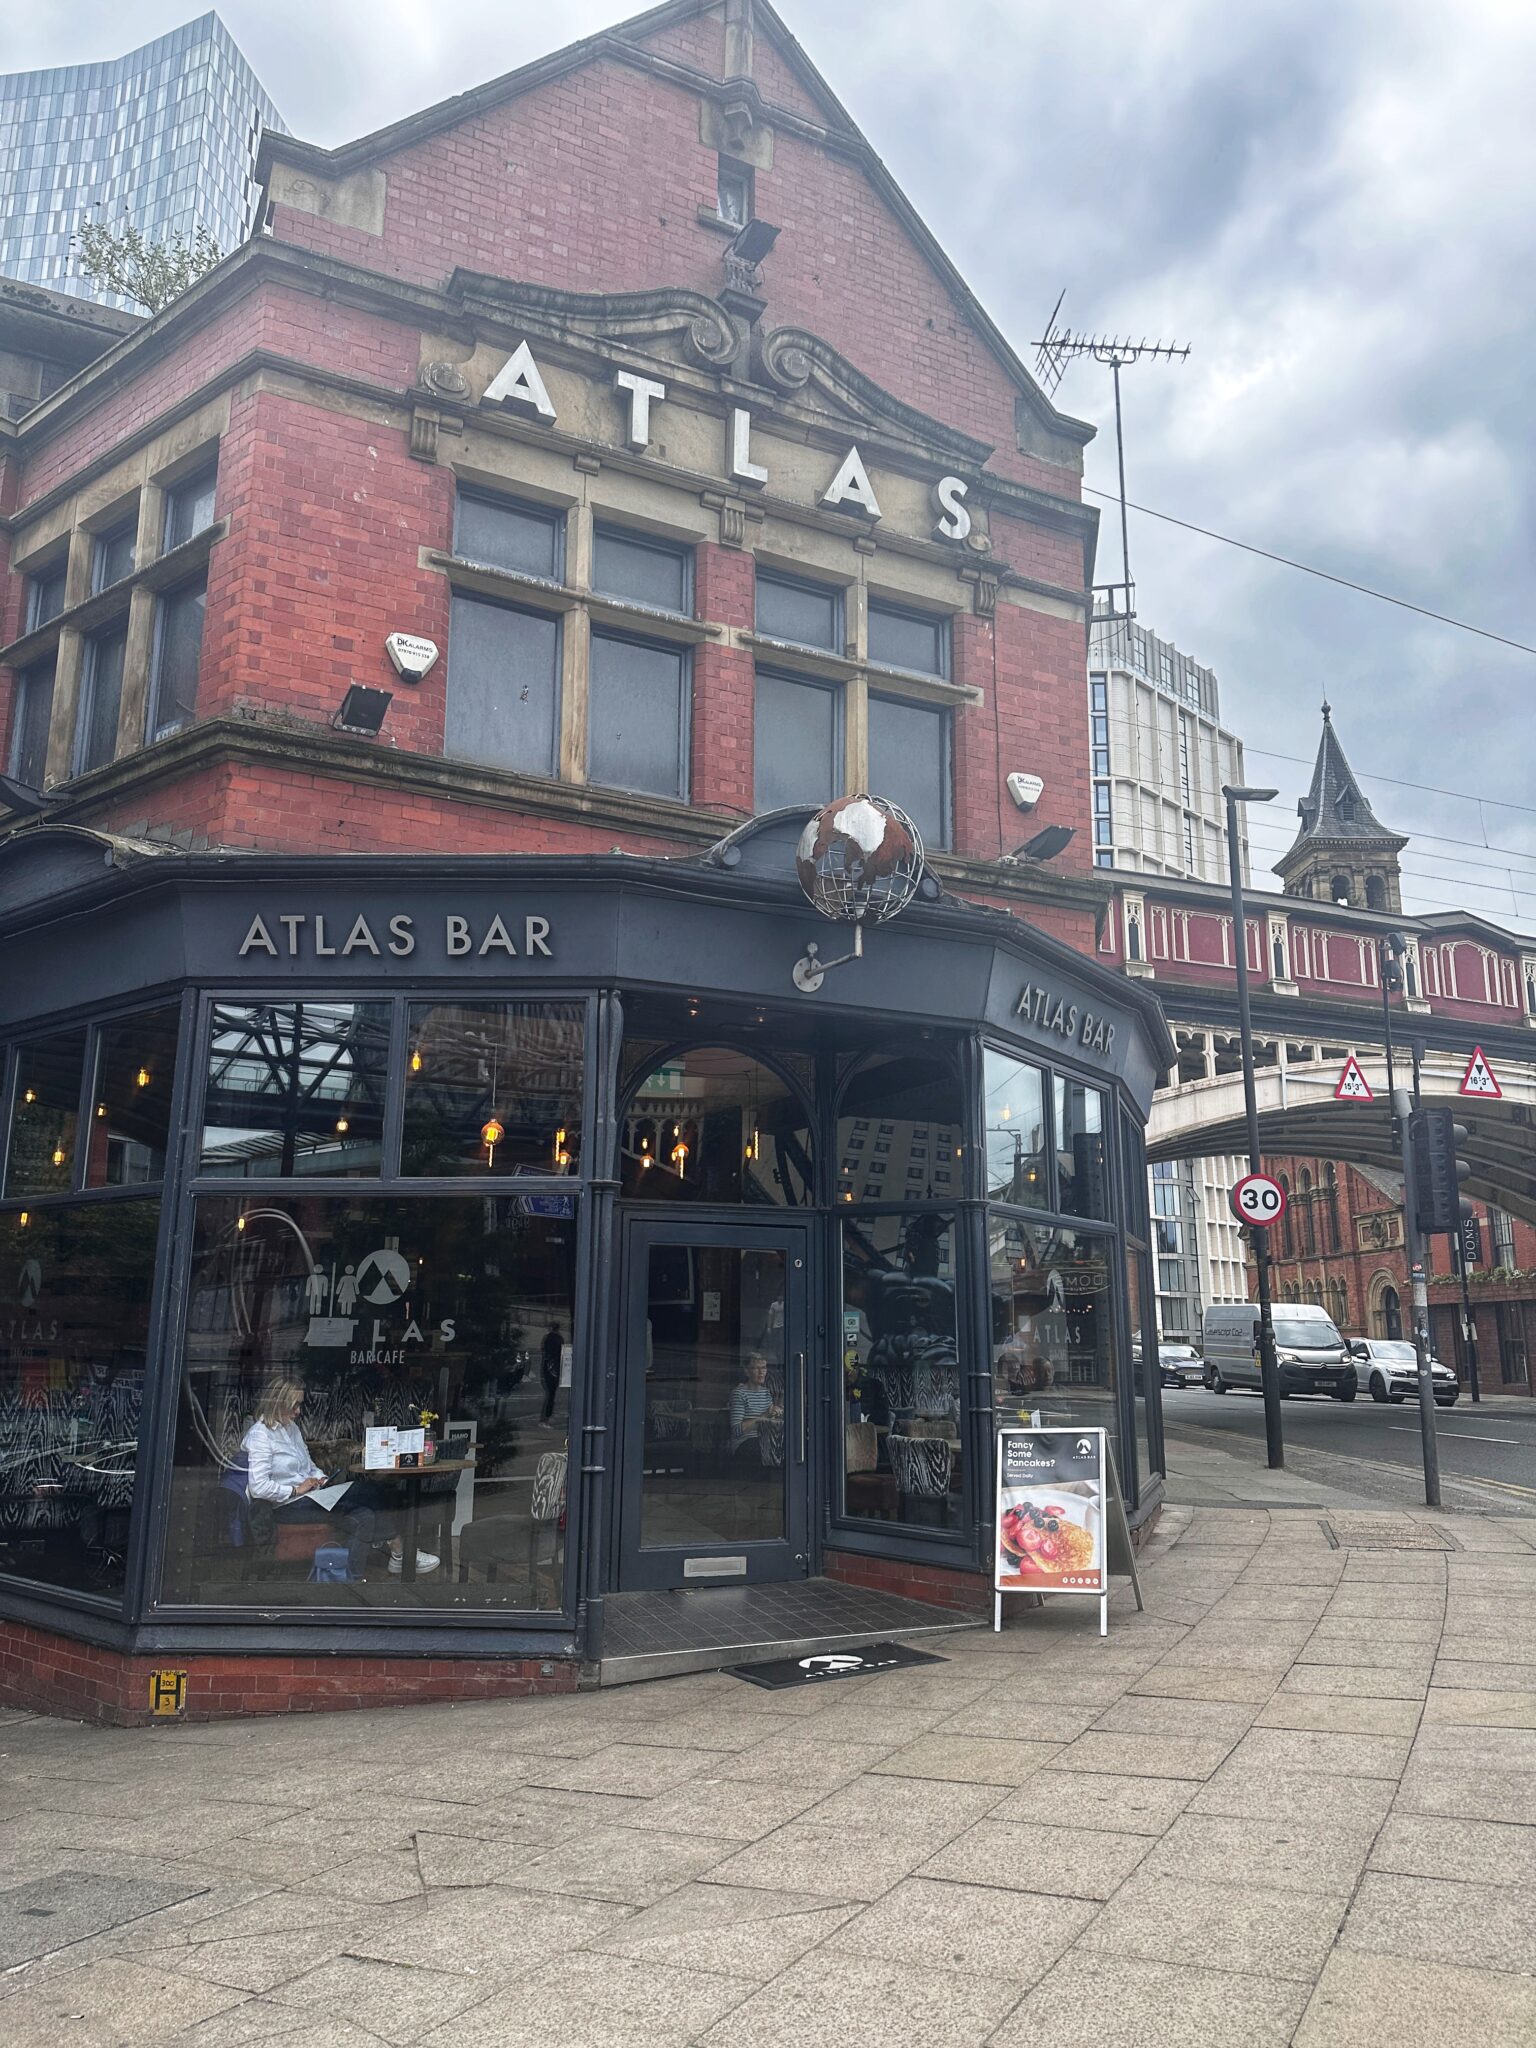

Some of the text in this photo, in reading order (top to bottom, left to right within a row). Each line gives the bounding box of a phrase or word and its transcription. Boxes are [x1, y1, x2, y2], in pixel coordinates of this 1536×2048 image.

[479, 339, 972, 541] ATLAS
[238, 913, 553, 955] ATLAS BAR
[1017, 981, 1116, 1055] ATLAS BAR
[1242, 1188, 1279, 1210] 30
[0, 1320, 59, 1340] TLAS
[303, 1318, 456, 1343] TLAS
[1033, 1324, 1081, 1344] ATLAS
[350, 1350, 372, 1364] BAR
[376, 1350, 406, 1364] CAFE
[1007, 1440, 1034, 1451] Fancy
[1007, 1450, 1032, 1458] Some
[1007, 1458, 1056, 1467] Pancakes?
[805, 1659, 899, 1678] ATLAS BAR
[164, 1697, 171, 1706] 3
